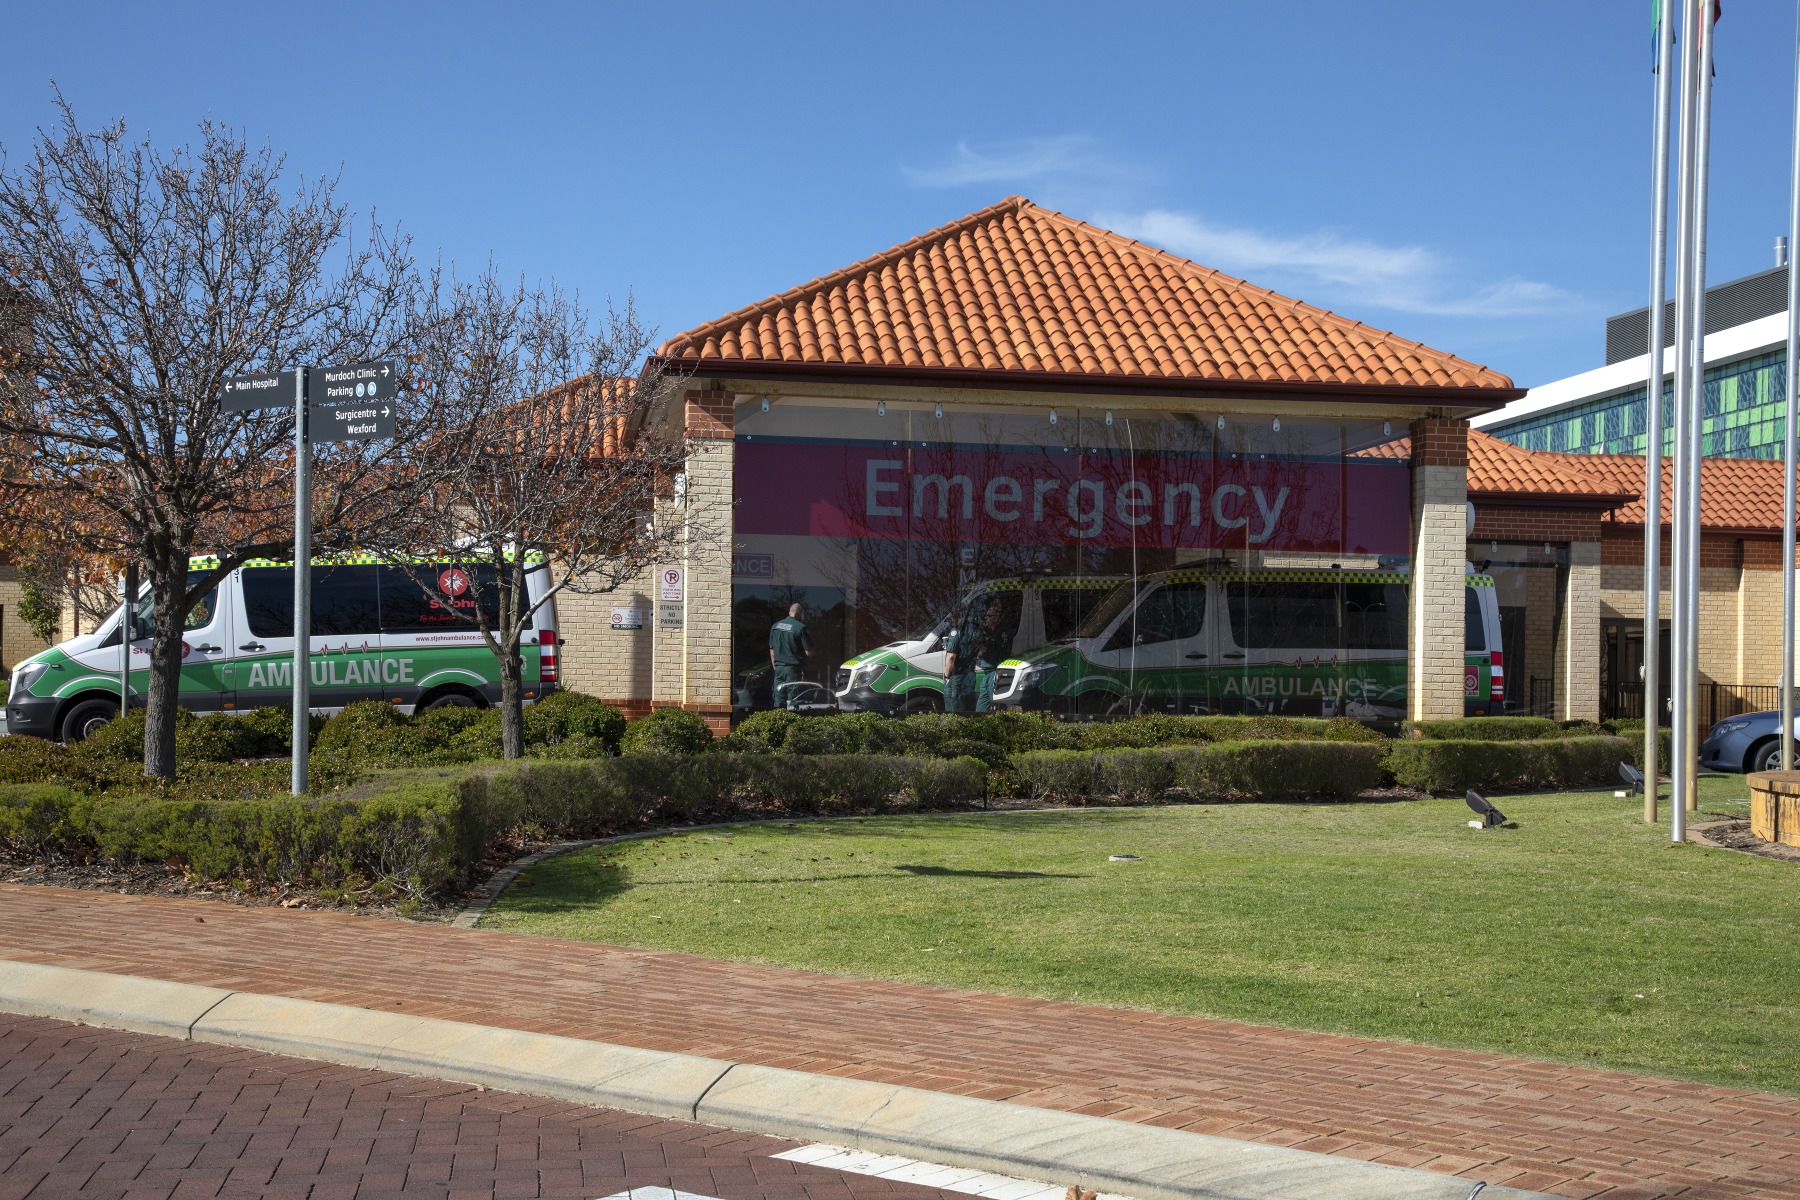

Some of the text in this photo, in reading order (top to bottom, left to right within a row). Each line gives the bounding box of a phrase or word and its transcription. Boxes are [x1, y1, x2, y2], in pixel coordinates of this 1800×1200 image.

[325, 368, 377, 382] Murdoch Clinic
[236, 377, 279, 390] Main Hospital
[327, 386, 353, 397] Parking
[335, 409, 376, 421] Surgicentre
[347, 423, 377, 434] Wexford
[865, 458, 1291, 543] Emergency
[132, 647, 143, 655] St
[247, 658, 415, 688] AMULANCE
[1222, 677, 1377, 697] AMBULANCE
